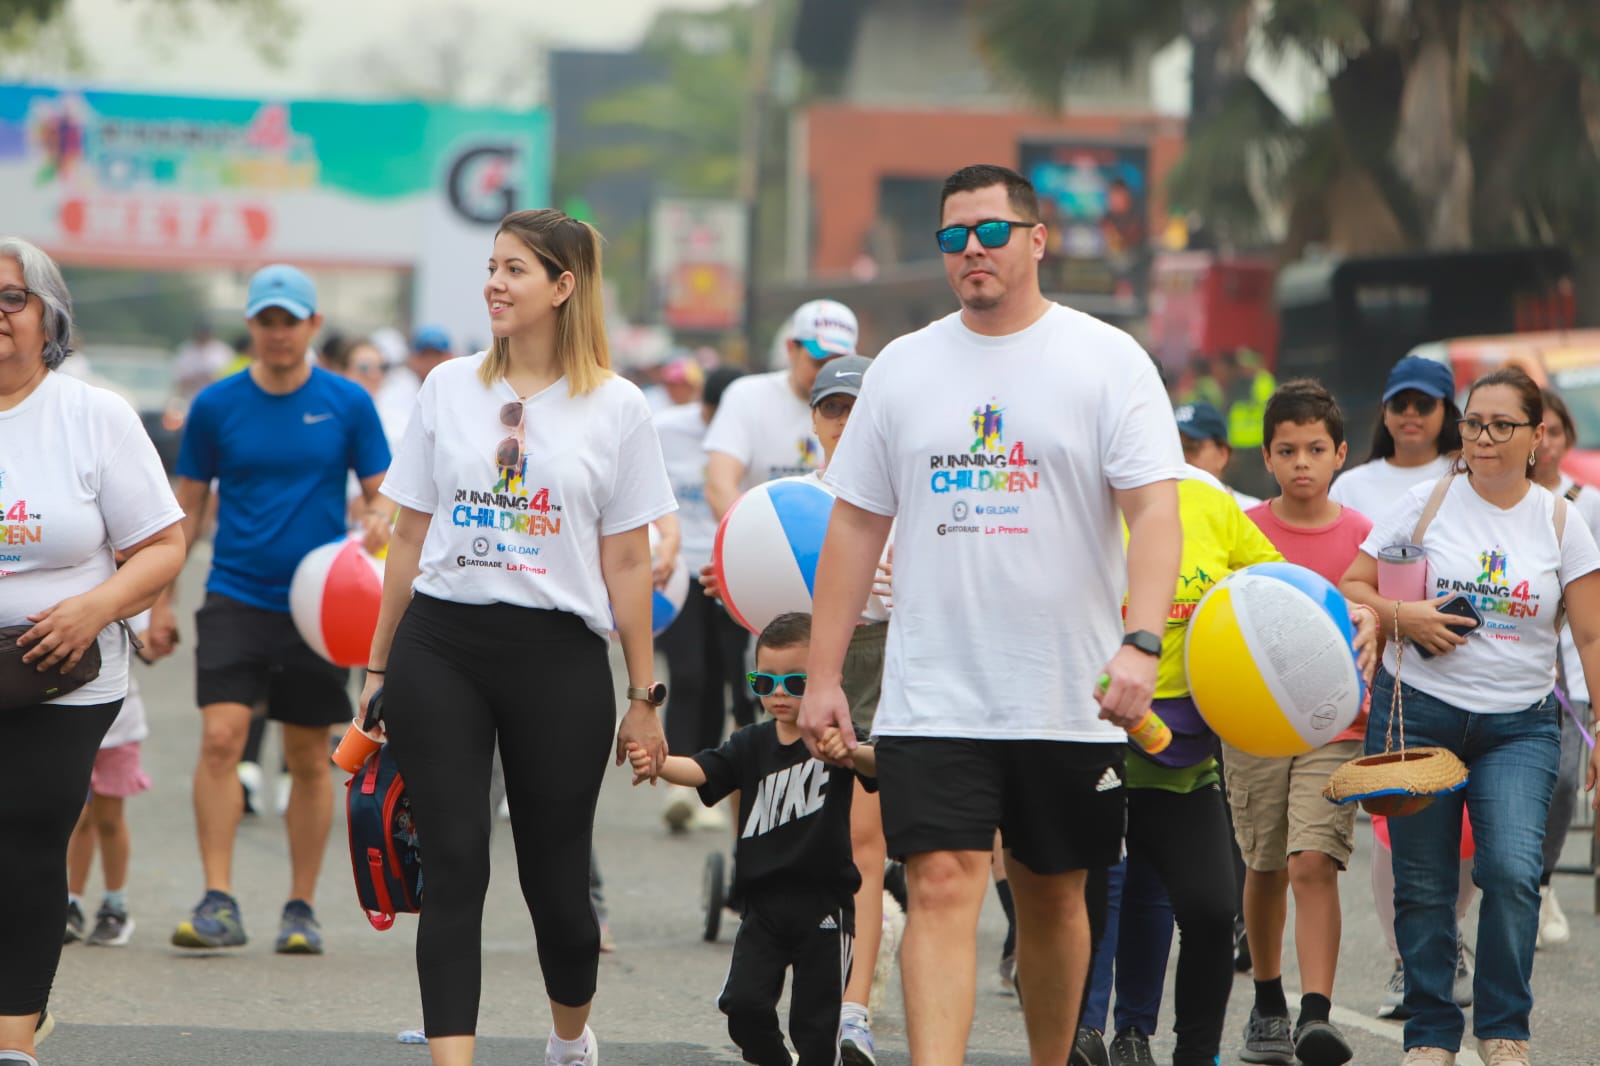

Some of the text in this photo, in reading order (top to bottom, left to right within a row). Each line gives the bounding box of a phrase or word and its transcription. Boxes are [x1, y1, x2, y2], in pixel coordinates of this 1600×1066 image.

[930, 454, 1007, 469] RUNNING
[1008, 441, 1028, 467] 4
[931, 470, 1039, 494] CHILDREN
[6, 500, 29, 523] 4
[455, 489, 529, 511] RUNNING
[529, 487, 551, 515] 4
[985, 506, 1019, 515] GILDAN
[452, 504, 561, 537] CHILDREN
[984, 526, 996, 535] La
[998, 525, 1030, 535] Prensa
[507, 543, 541, 556] GILDAN
[466, 559, 503, 568] GATORADE
[506, 562, 518, 571] La
[519, 563, 547, 575] Prensa
[1437, 578, 1510, 597] RUNNING
[1511, 579, 1531, 602] 4
[741, 757, 830, 839] NIKE
